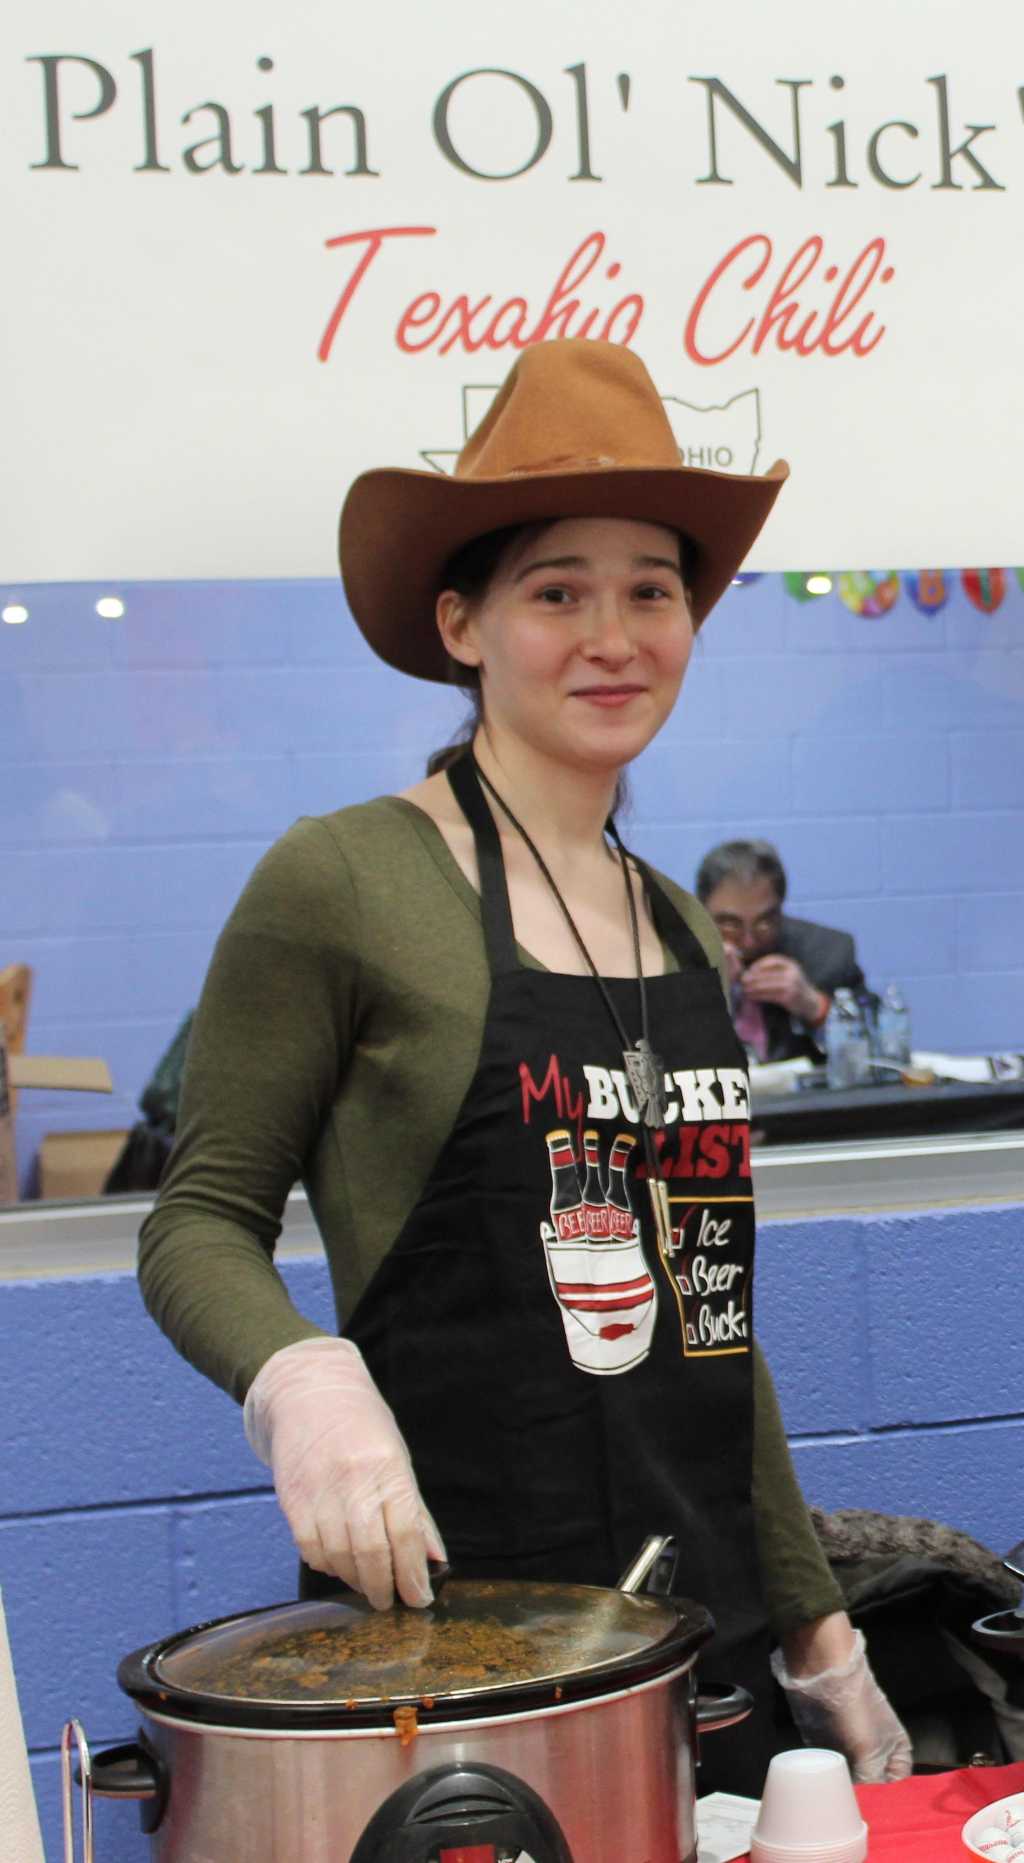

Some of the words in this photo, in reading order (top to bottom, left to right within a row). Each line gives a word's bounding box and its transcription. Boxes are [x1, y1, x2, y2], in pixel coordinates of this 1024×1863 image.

[25, 47, 380, 177] Plain
[432, 62, 631, 182] Ol'
[683, 233, 896, 367] Chili
[678, 446, 734, 467] HIO
[518, 1054, 585, 1163] My
[697, 1209, 732, 1247] Ice
[692, 1255, 743, 1297] Beer
[700, 1301, 748, 1346] Buck
